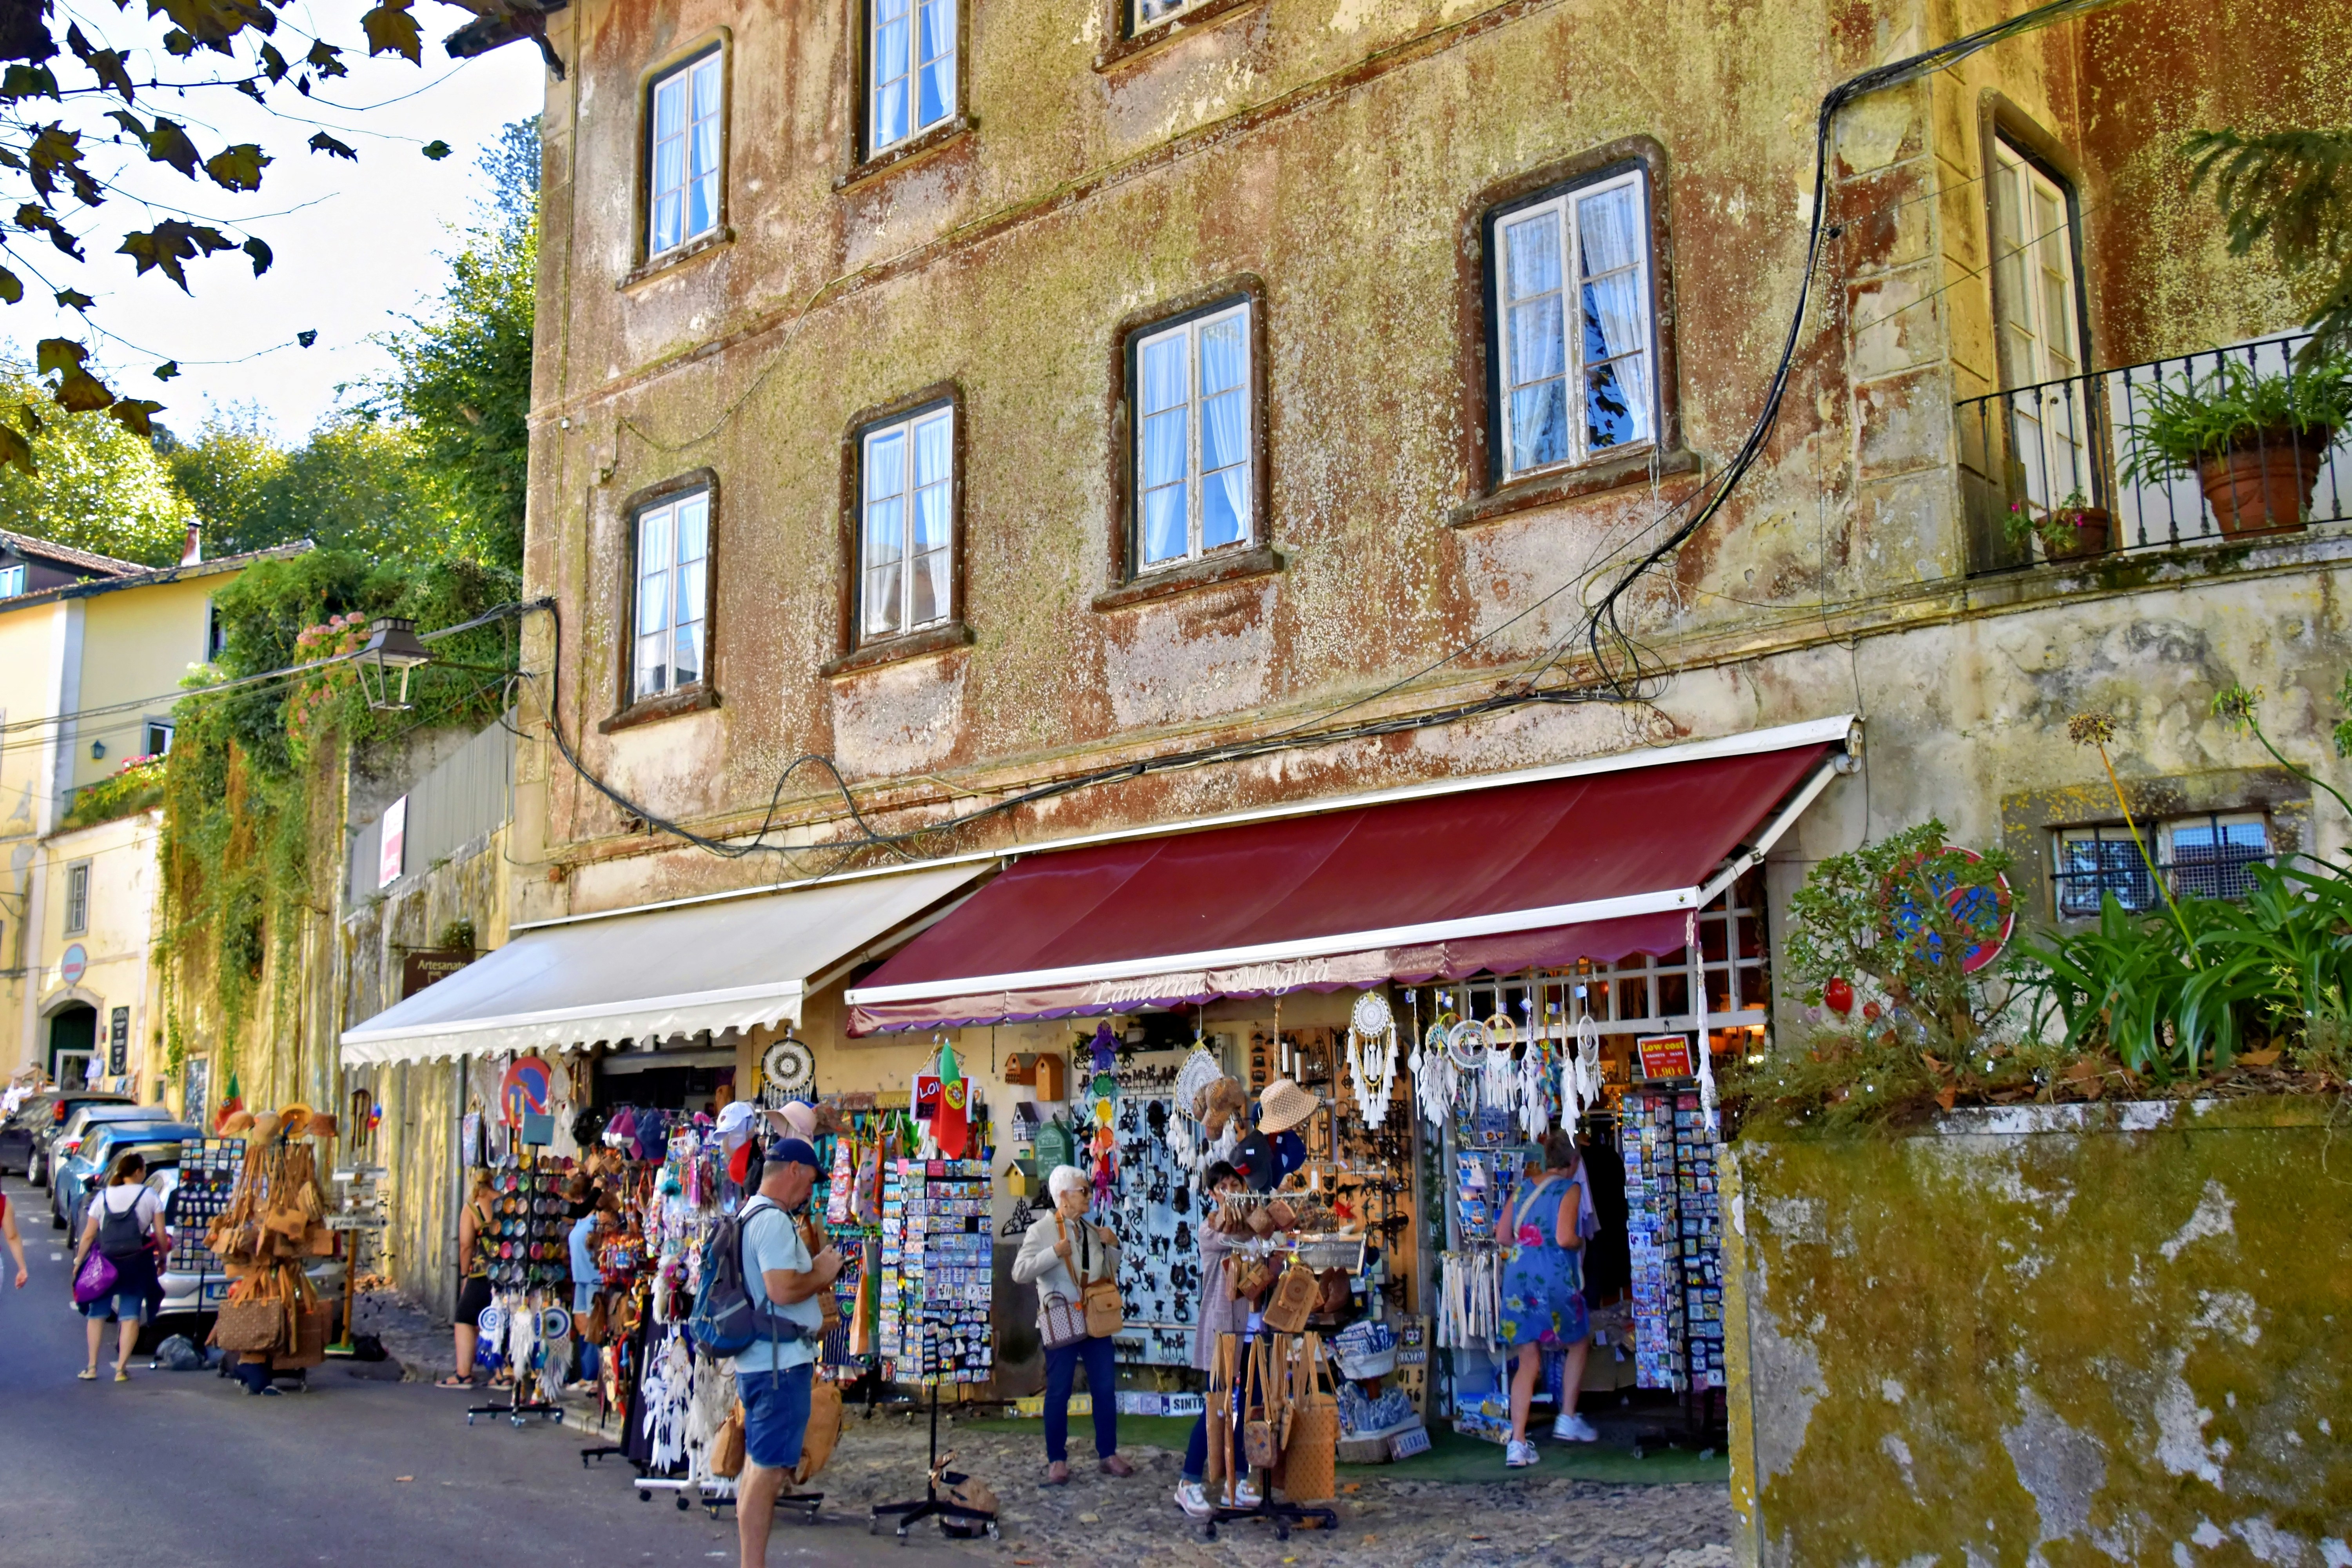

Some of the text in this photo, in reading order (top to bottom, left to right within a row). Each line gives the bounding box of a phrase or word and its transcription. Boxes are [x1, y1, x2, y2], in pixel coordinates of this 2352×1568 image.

[1092, 978, 1205, 1005] Lanterna
[1641, 1041, 1685, 1052] Low cost
